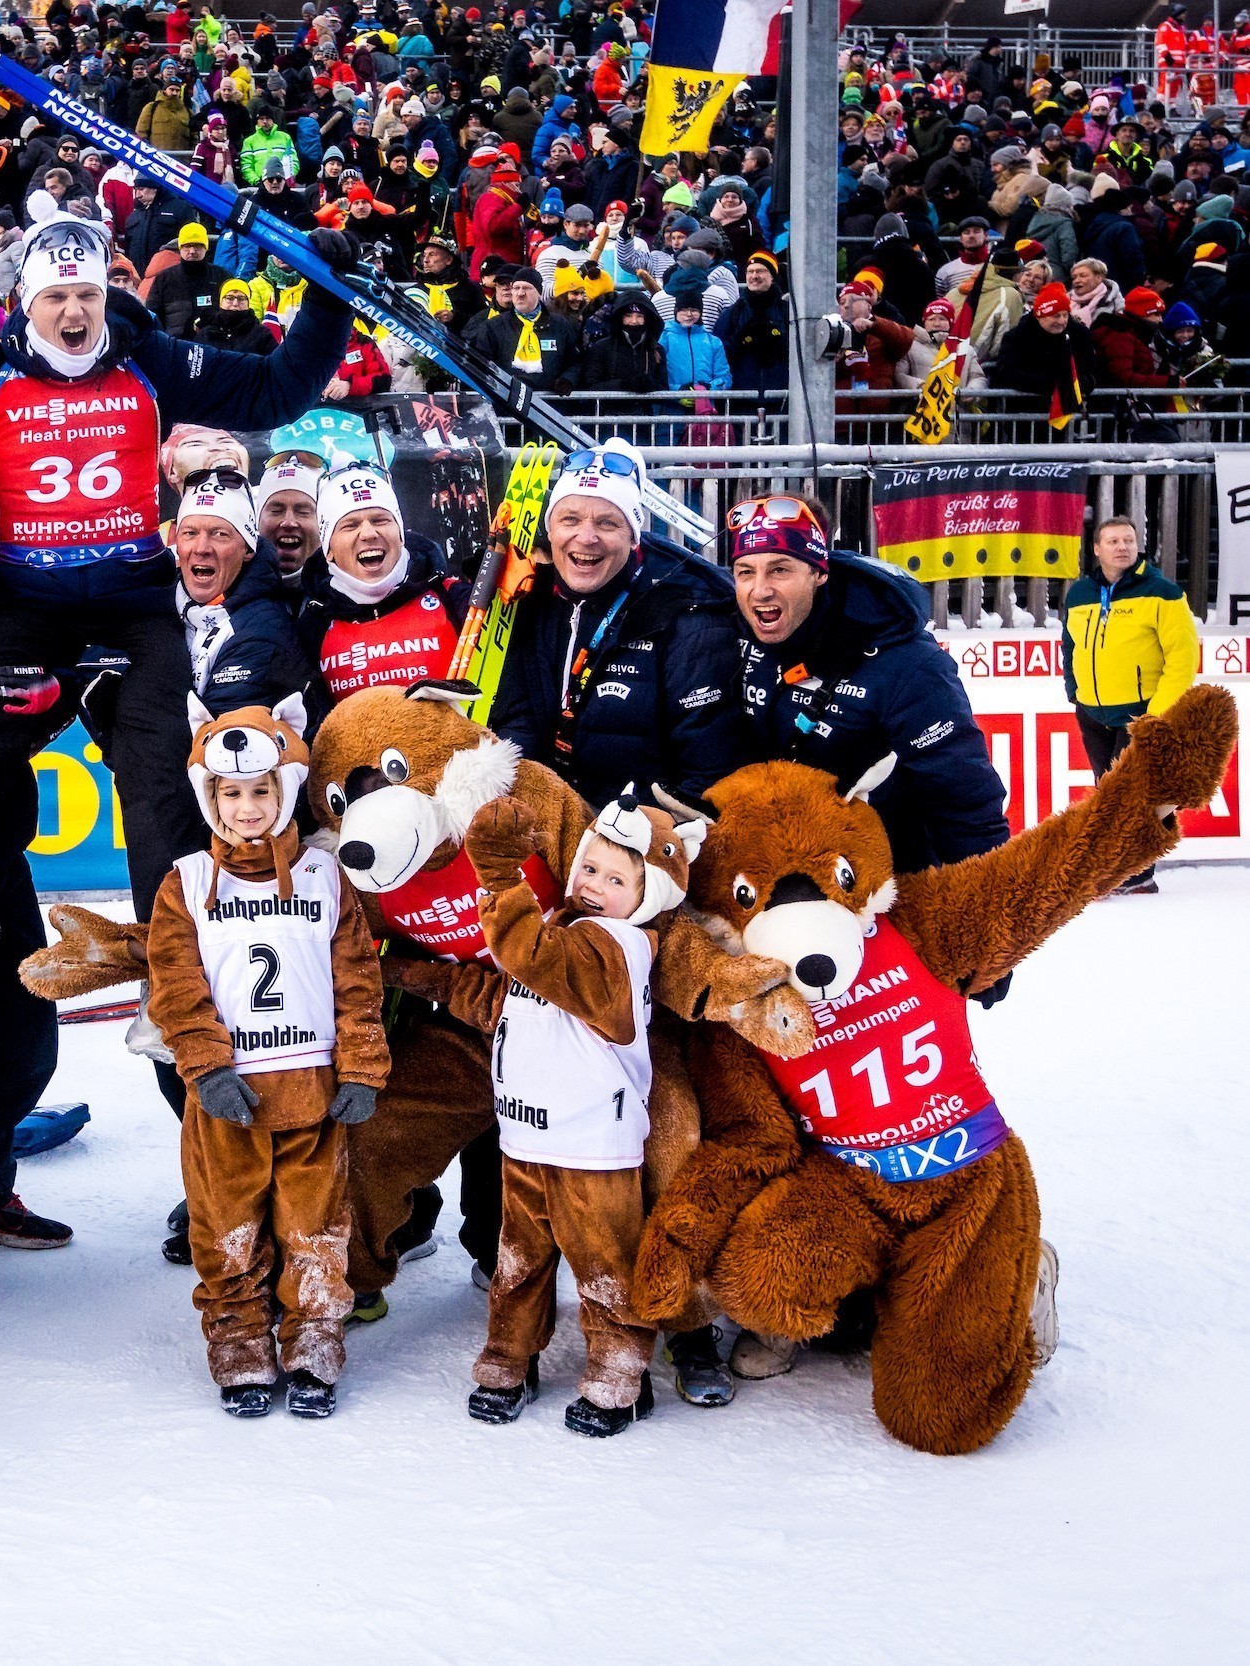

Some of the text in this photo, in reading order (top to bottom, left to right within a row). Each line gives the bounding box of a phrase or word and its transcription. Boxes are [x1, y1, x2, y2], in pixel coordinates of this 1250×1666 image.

[42, 99, 168, 179] SALOMON
[49, 88, 170, 164] SALOMON
[48, 247, 85, 264] ice
[350, 295, 440, 360] SALOMON
[6, 396, 139, 425] VIESSMANN
[20, 423, 127, 444] Heat pumps
[25, 450, 124, 504] 36
[339, 477, 378, 495] ice
[926, 464, 969, 482] Perle
[974, 462, 1005, 479] der
[943, 494, 1019, 518] grüßt die
[12, 512, 144, 535] RUHPOLDING
[107, 525, 145, 538] ALPEN
[943, 518, 1021, 536] Biathleten
[470, 551, 492, 605] ONE WAY
[320, 636, 440, 674] VIESSMANN
[330, 664, 429, 694] Heat pumps
[600, 685, 628, 697] MENY
[678, 688, 722, 705] HURTIGRUTA
[684, 694, 722, 710] CARGLASS
[910, 720, 955, 747] HURTIGRUTA
[916, 726, 955, 749] CARGLASS
[207, 894, 323, 924] Ruhpolding
[394, 886, 490, 928] VIESSMA
[248, 942, 284, 1013] 2
[808, 964, 911, 1029] SSMANN
[800, 1020, 944, 1118] 115
[612, 1087, 626, 1122] 1
[897, 1126, 978, 1178] iX2
